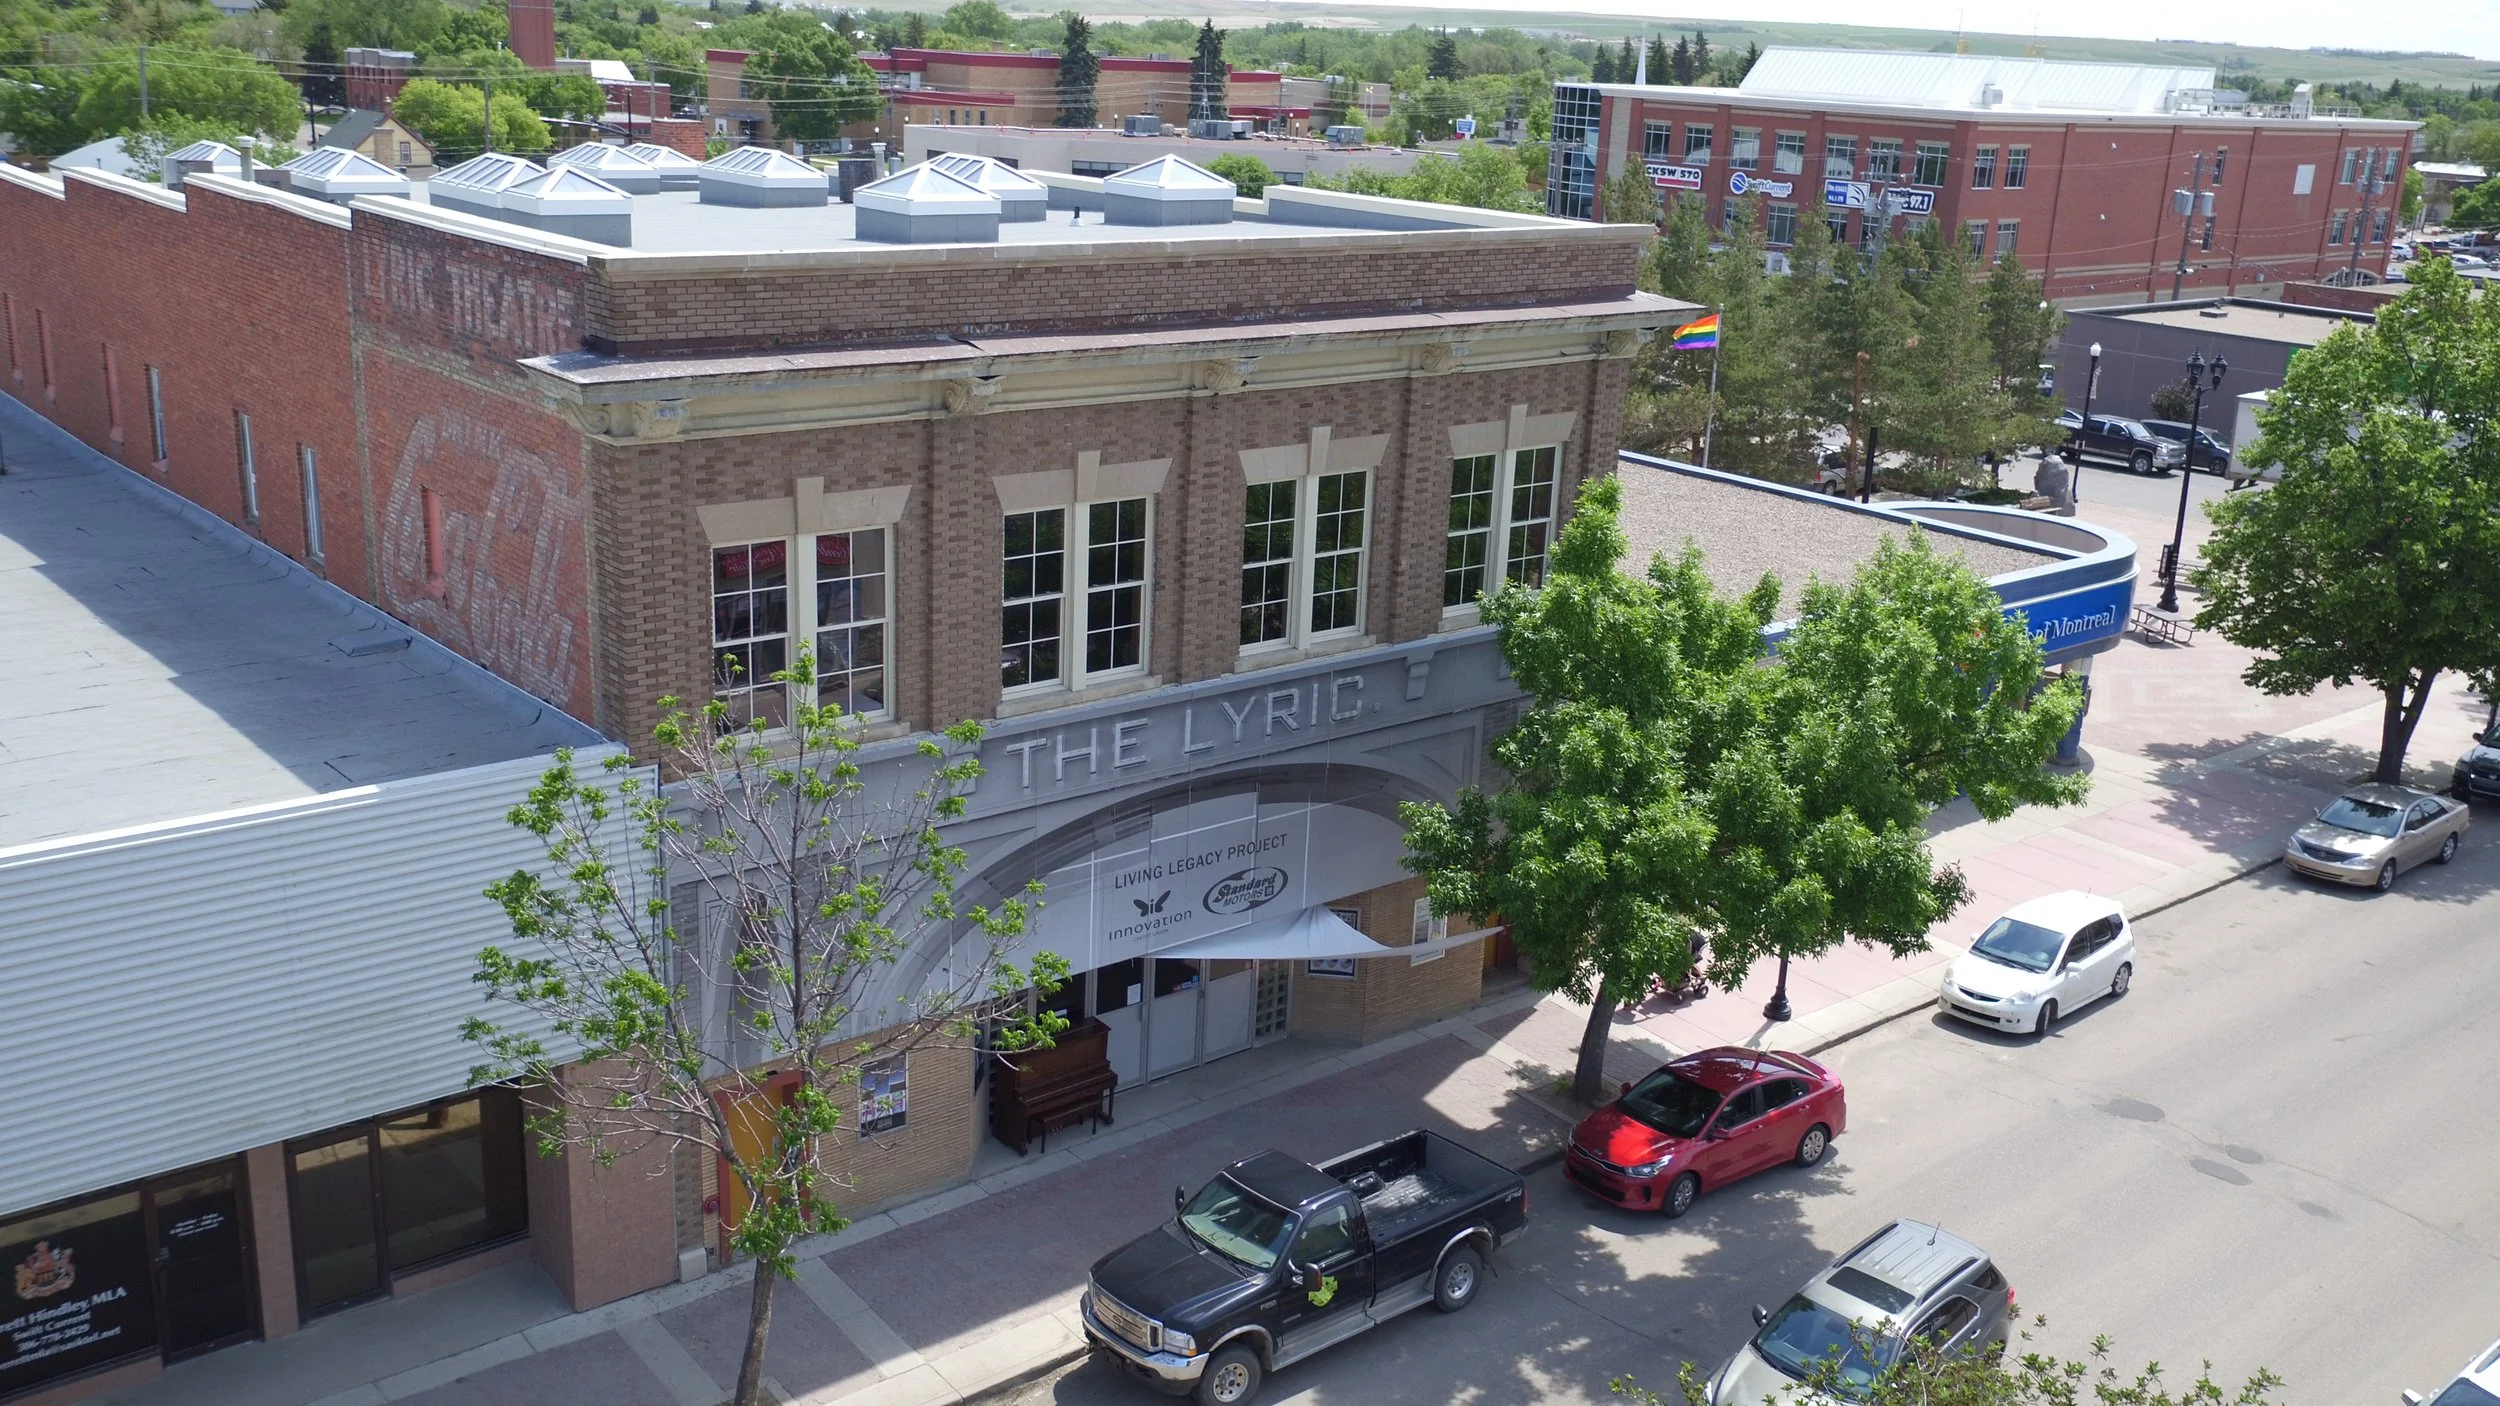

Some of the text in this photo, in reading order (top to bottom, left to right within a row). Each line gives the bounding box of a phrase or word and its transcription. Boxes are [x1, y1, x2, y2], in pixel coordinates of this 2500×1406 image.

[1646, 166, 1700, 180] CKSW 570
[1909, 195, 1928, 210] 97.1
[2051, 604, 2116, 640] Montreal
[1005, 717, 1150, 789] THE
[1115, 833, 1287, 889] LIVING LEGACY PROJECT
[1213, 871, 1277, 903] Standard
[1223, 888, 1263, 907] MOTORS
[1108, 909, 1192, 941] innovation
[91, 1286, 128, 1307] MLA
